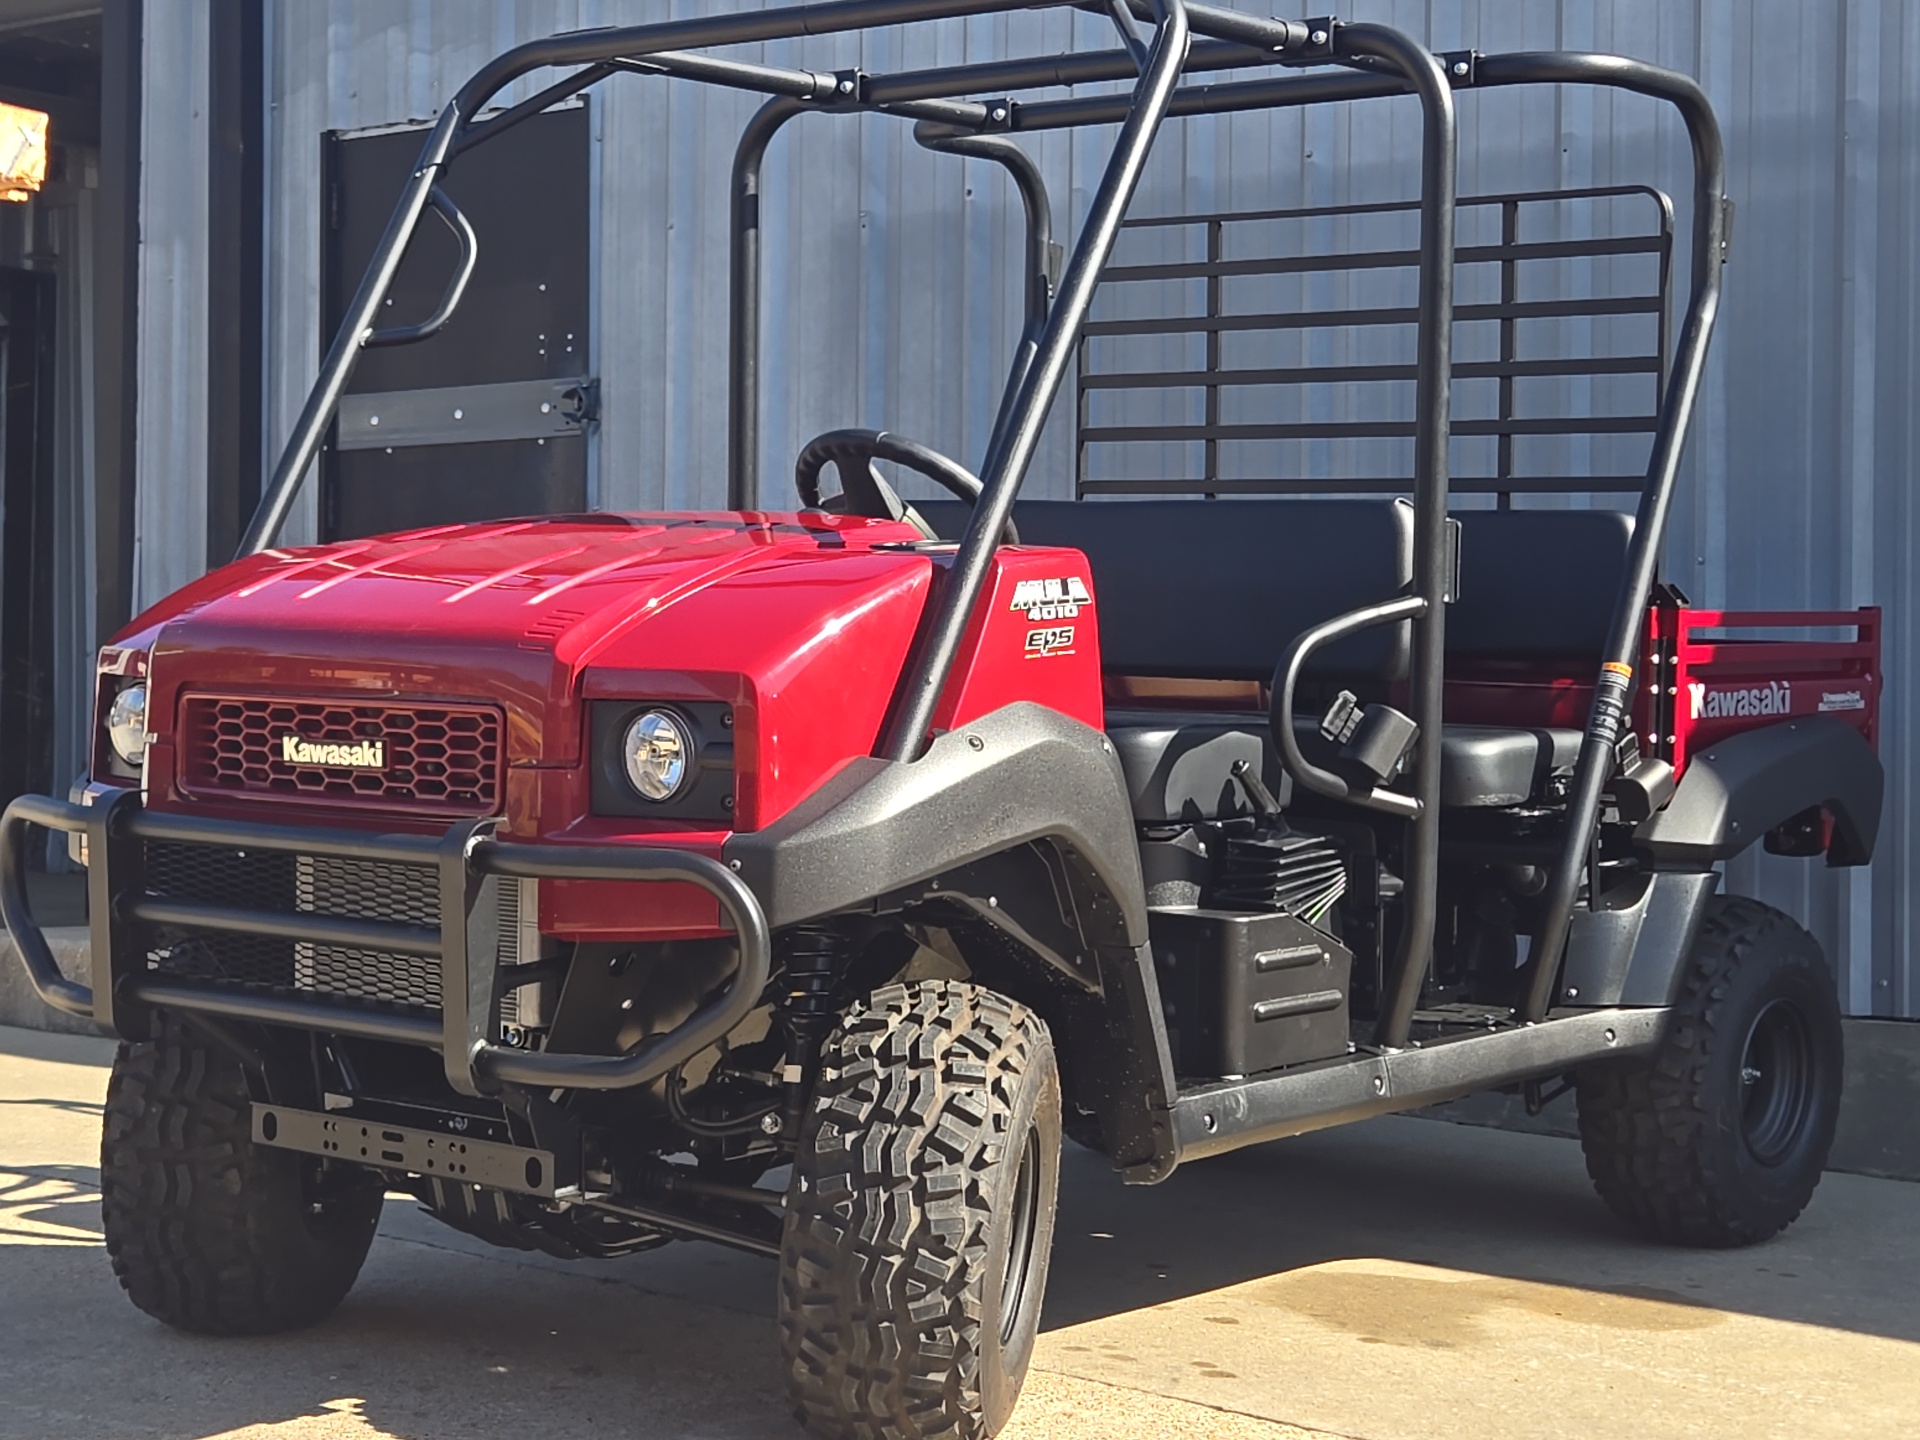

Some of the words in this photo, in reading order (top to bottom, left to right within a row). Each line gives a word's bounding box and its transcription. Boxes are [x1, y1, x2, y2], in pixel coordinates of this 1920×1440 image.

[1027, 604, 1079, 621] 4010
[1026, 627, 1074, 651] EPS
[1687, 681, 1791, 719] Kawasaki
[282, 736, 383, 767] Kawasaki
